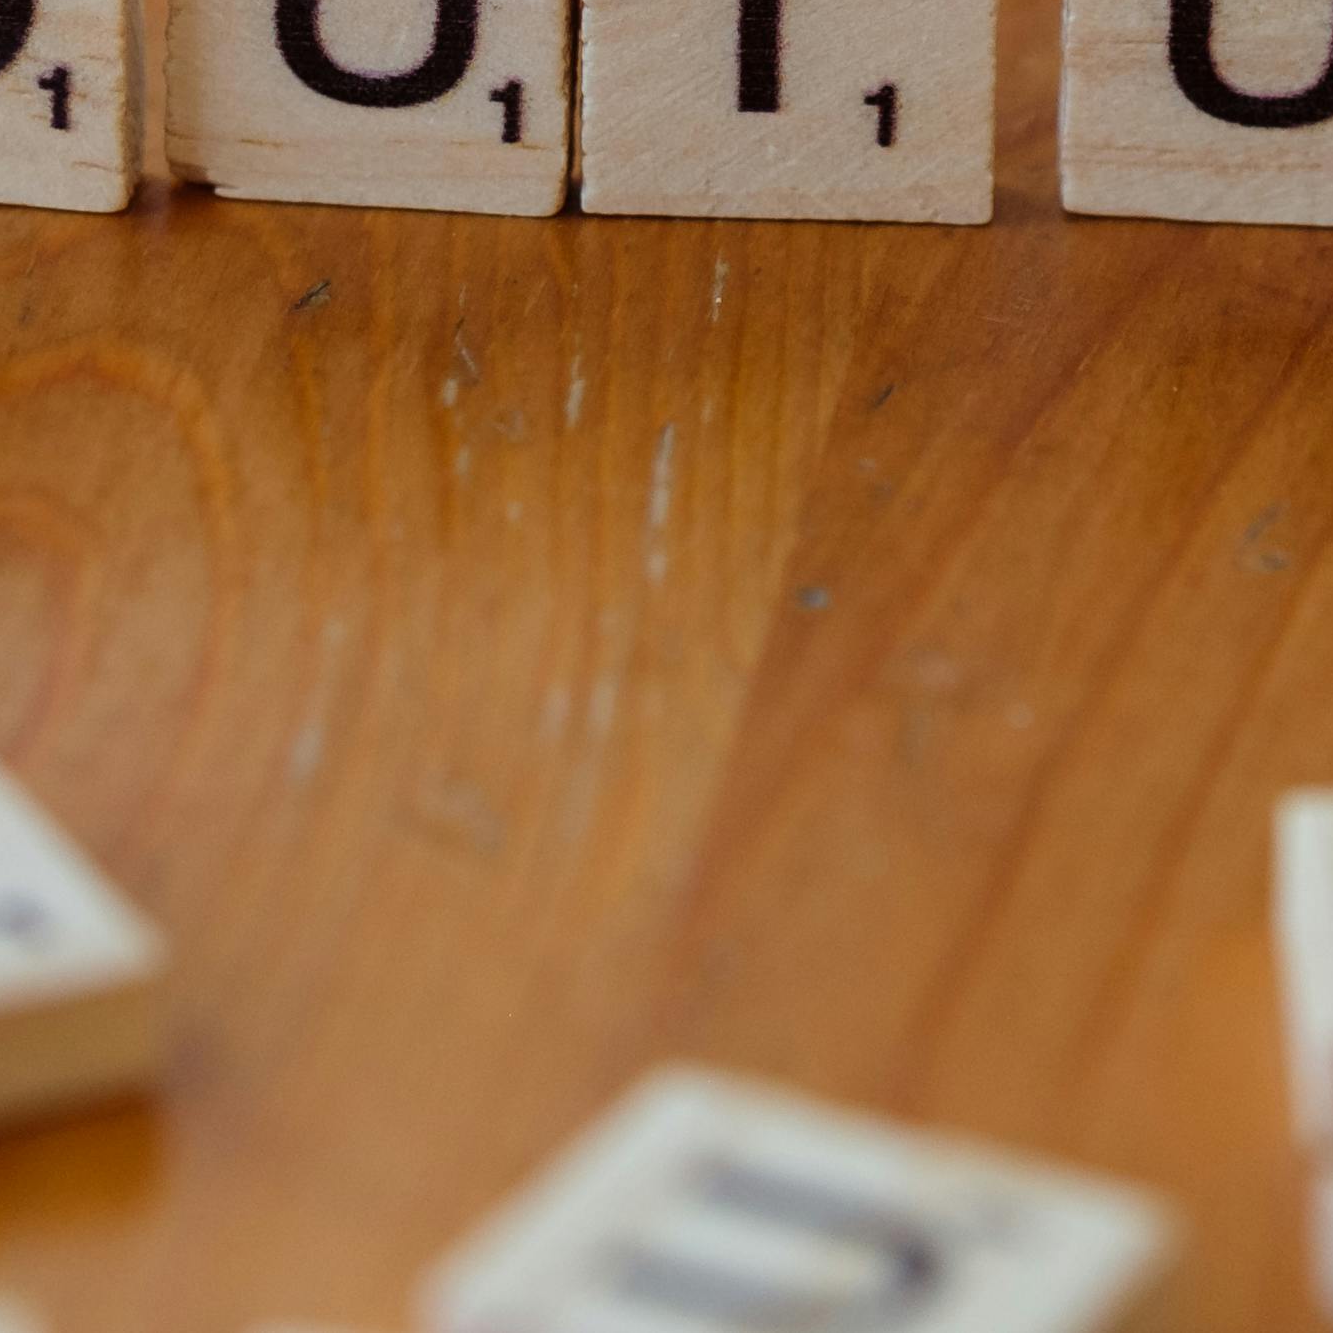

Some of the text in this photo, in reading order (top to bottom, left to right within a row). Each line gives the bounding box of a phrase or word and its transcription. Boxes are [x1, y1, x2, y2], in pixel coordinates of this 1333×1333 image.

[36, 65, 73, 132] 1
[488, 78, 525, 146] 1
[863, 82, 900, 149] 1
